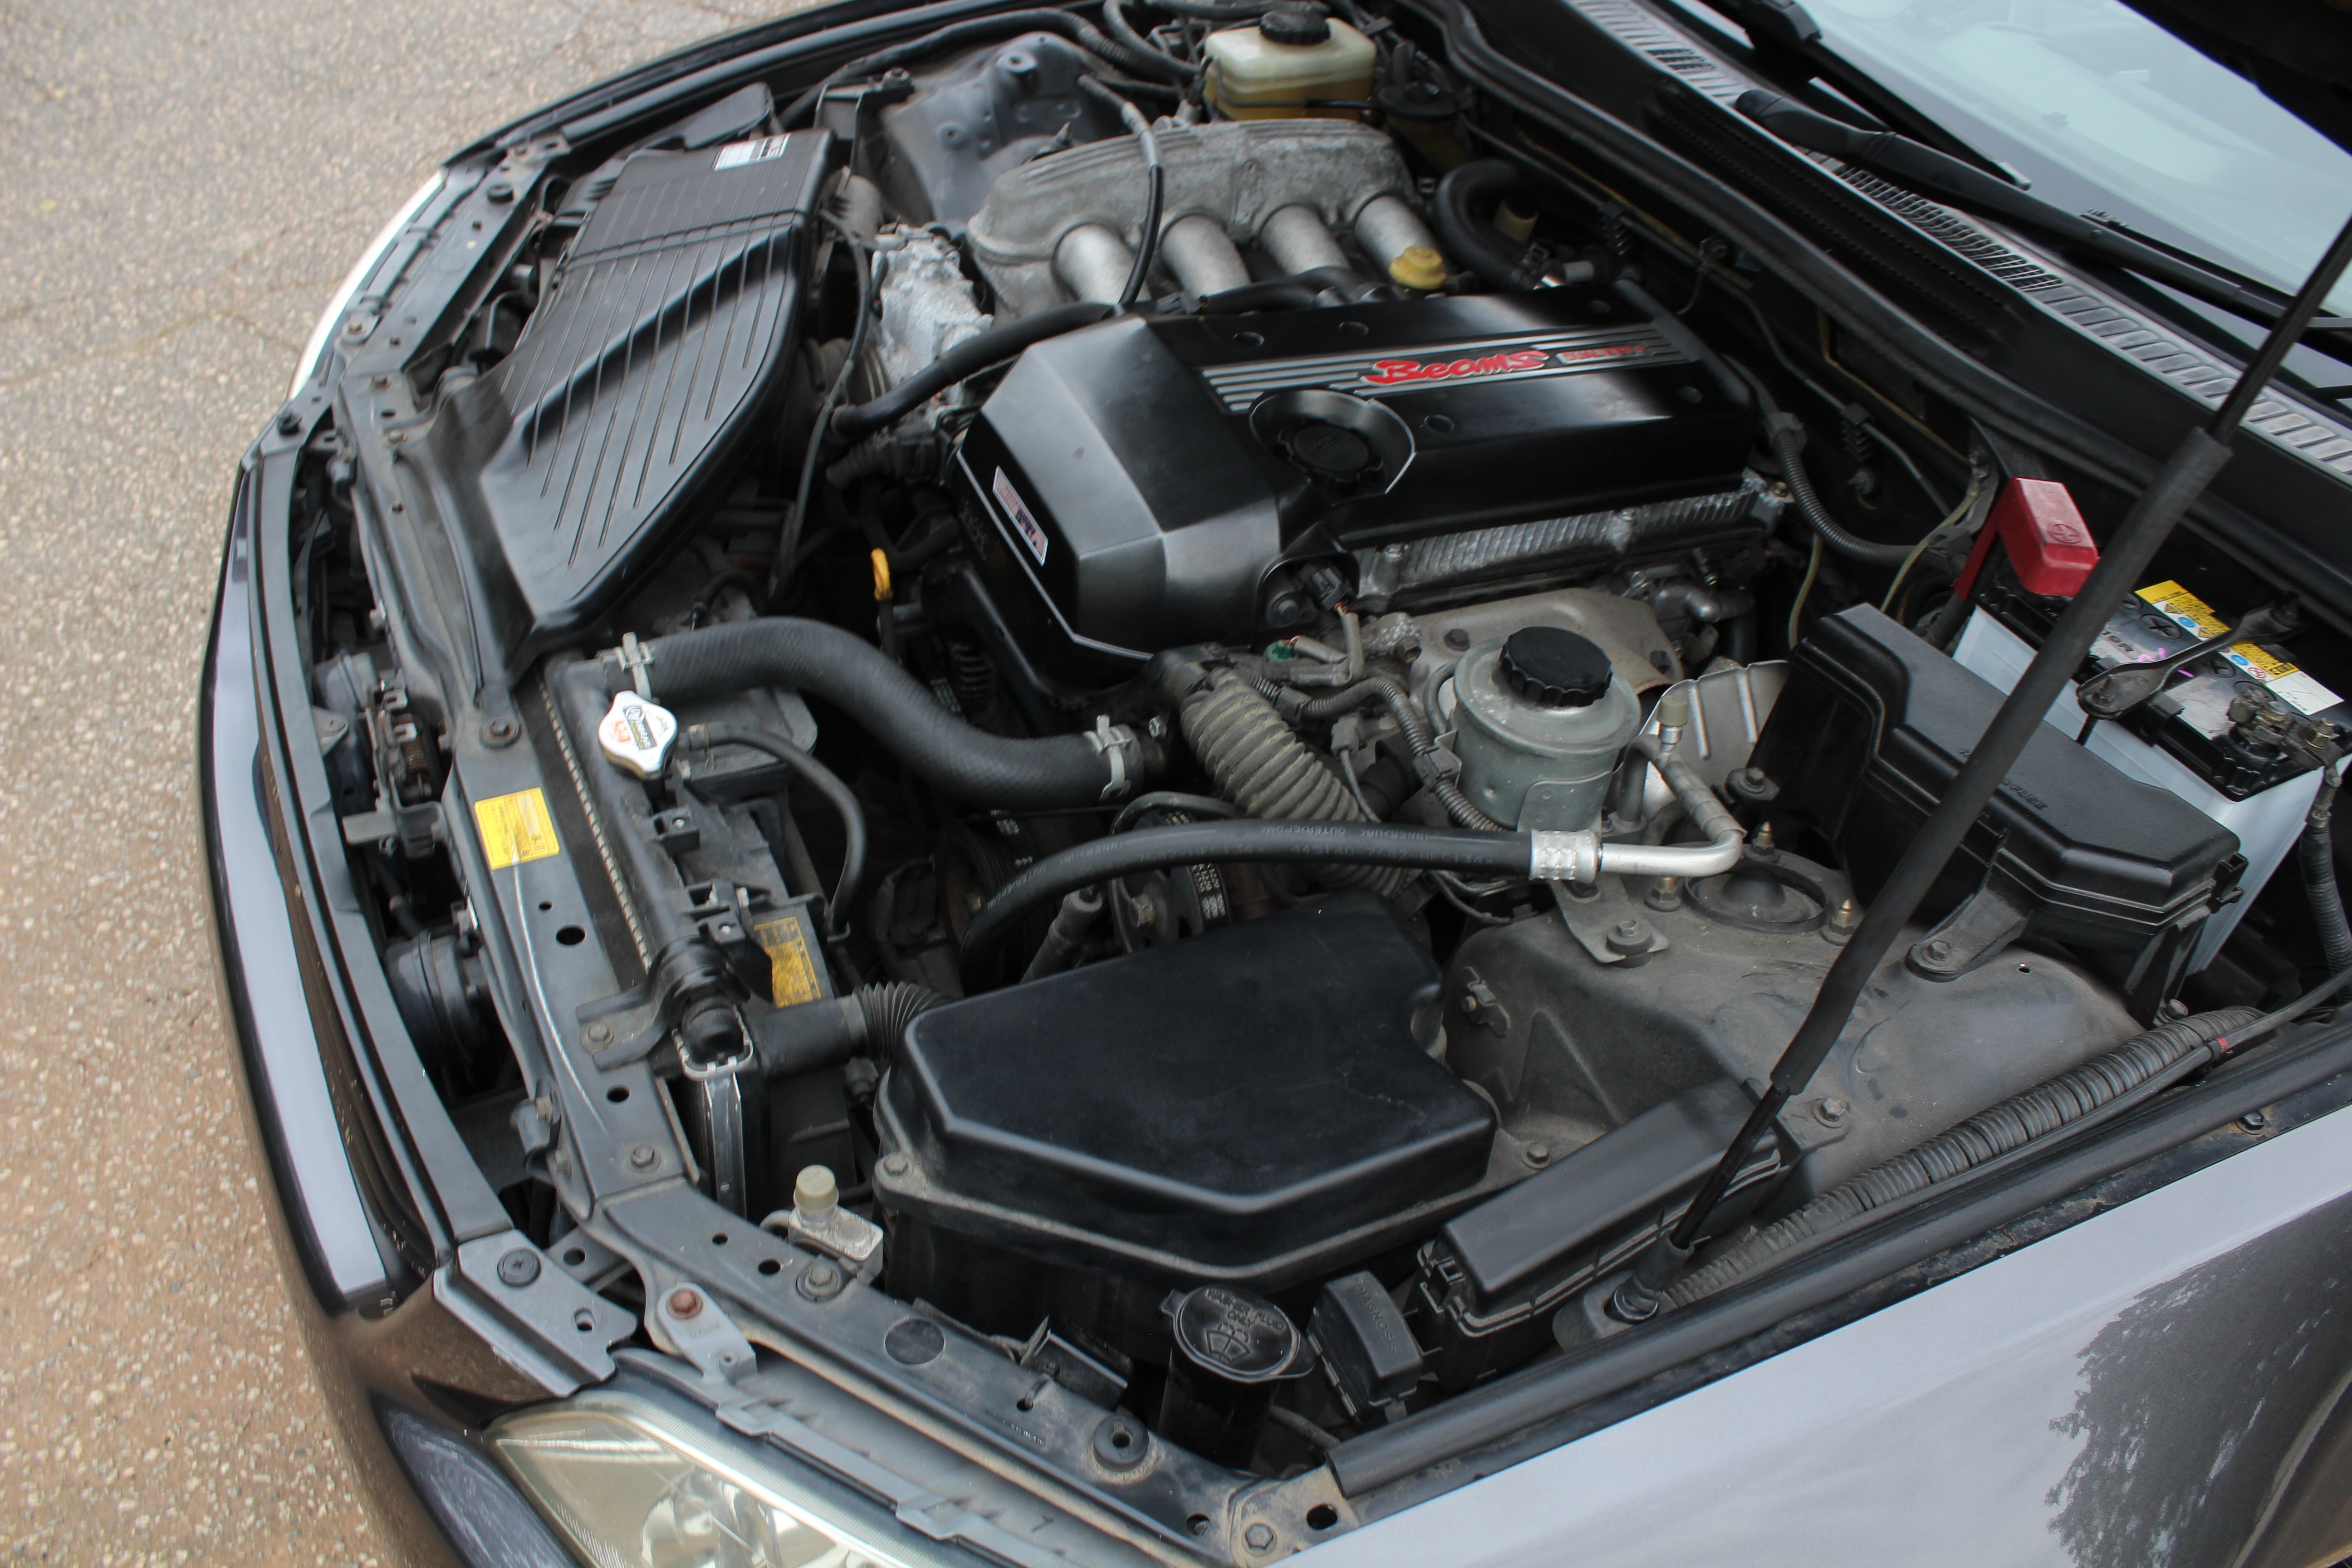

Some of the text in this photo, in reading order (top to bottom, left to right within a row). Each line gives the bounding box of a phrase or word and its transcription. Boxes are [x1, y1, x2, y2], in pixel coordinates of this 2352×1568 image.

[2010, 784, 2048, 811] FUSE
[1227, 1309, 1255, 1328] ONLY
[1353, 1284, 1399, 1353] DIAGNOSIS
